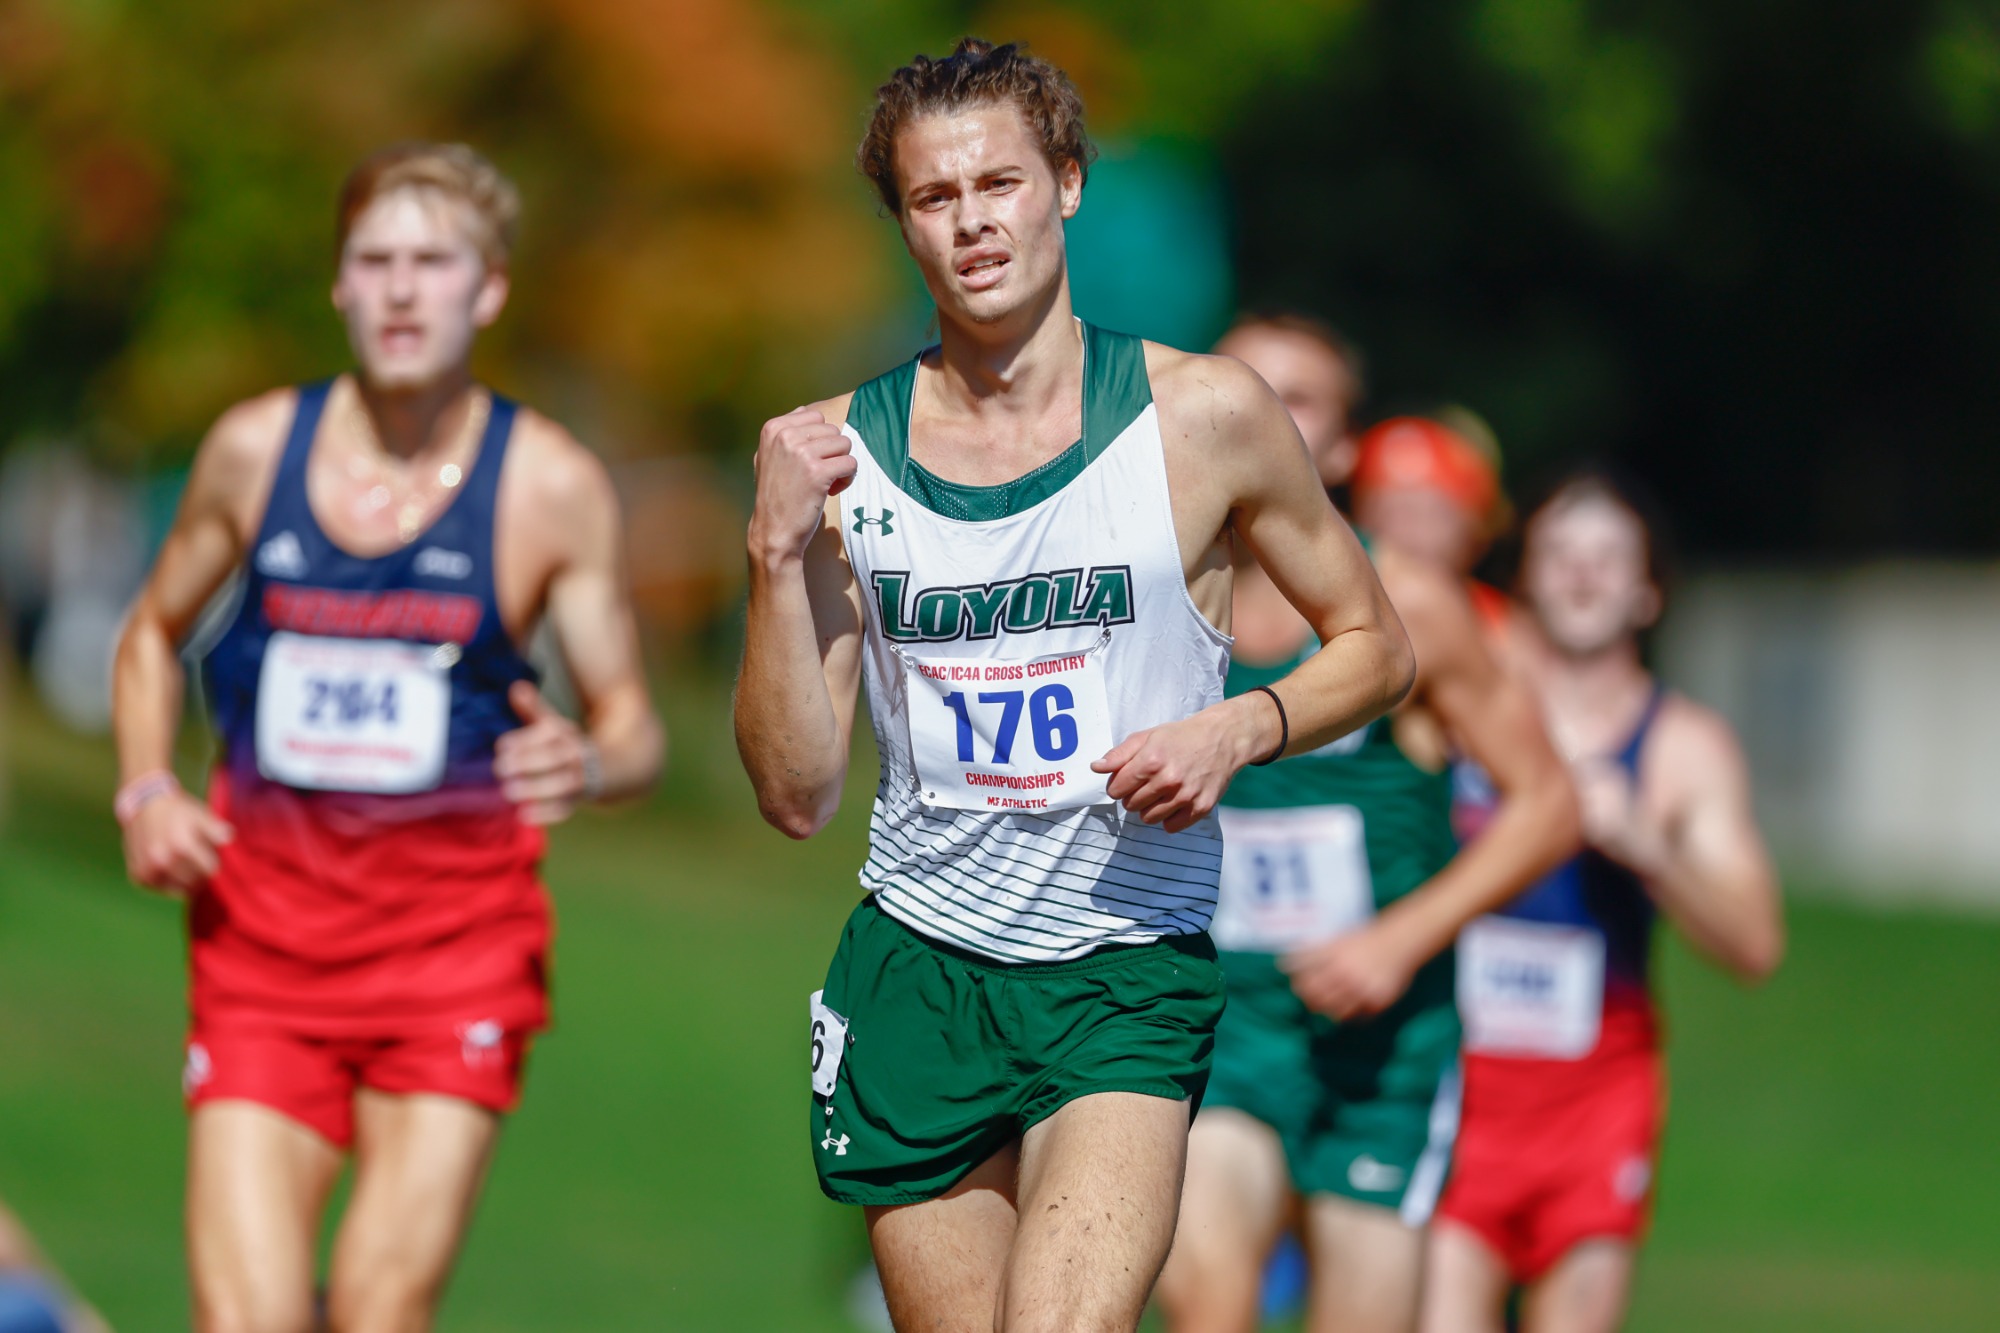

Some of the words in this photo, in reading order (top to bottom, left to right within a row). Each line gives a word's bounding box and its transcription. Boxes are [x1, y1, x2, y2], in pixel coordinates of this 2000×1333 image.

[871, 565, 1135, 643] LOYOLA
[984, 666, 1023, 681] CROSS
[1027, 655, 1086, 678] COUNTRY
[942, 683, 1079, 764] 176
[965, 771, 1065, 790] CHAMPIONSHIPS
[1001, 798, 1048, 809] ATHLETIC
